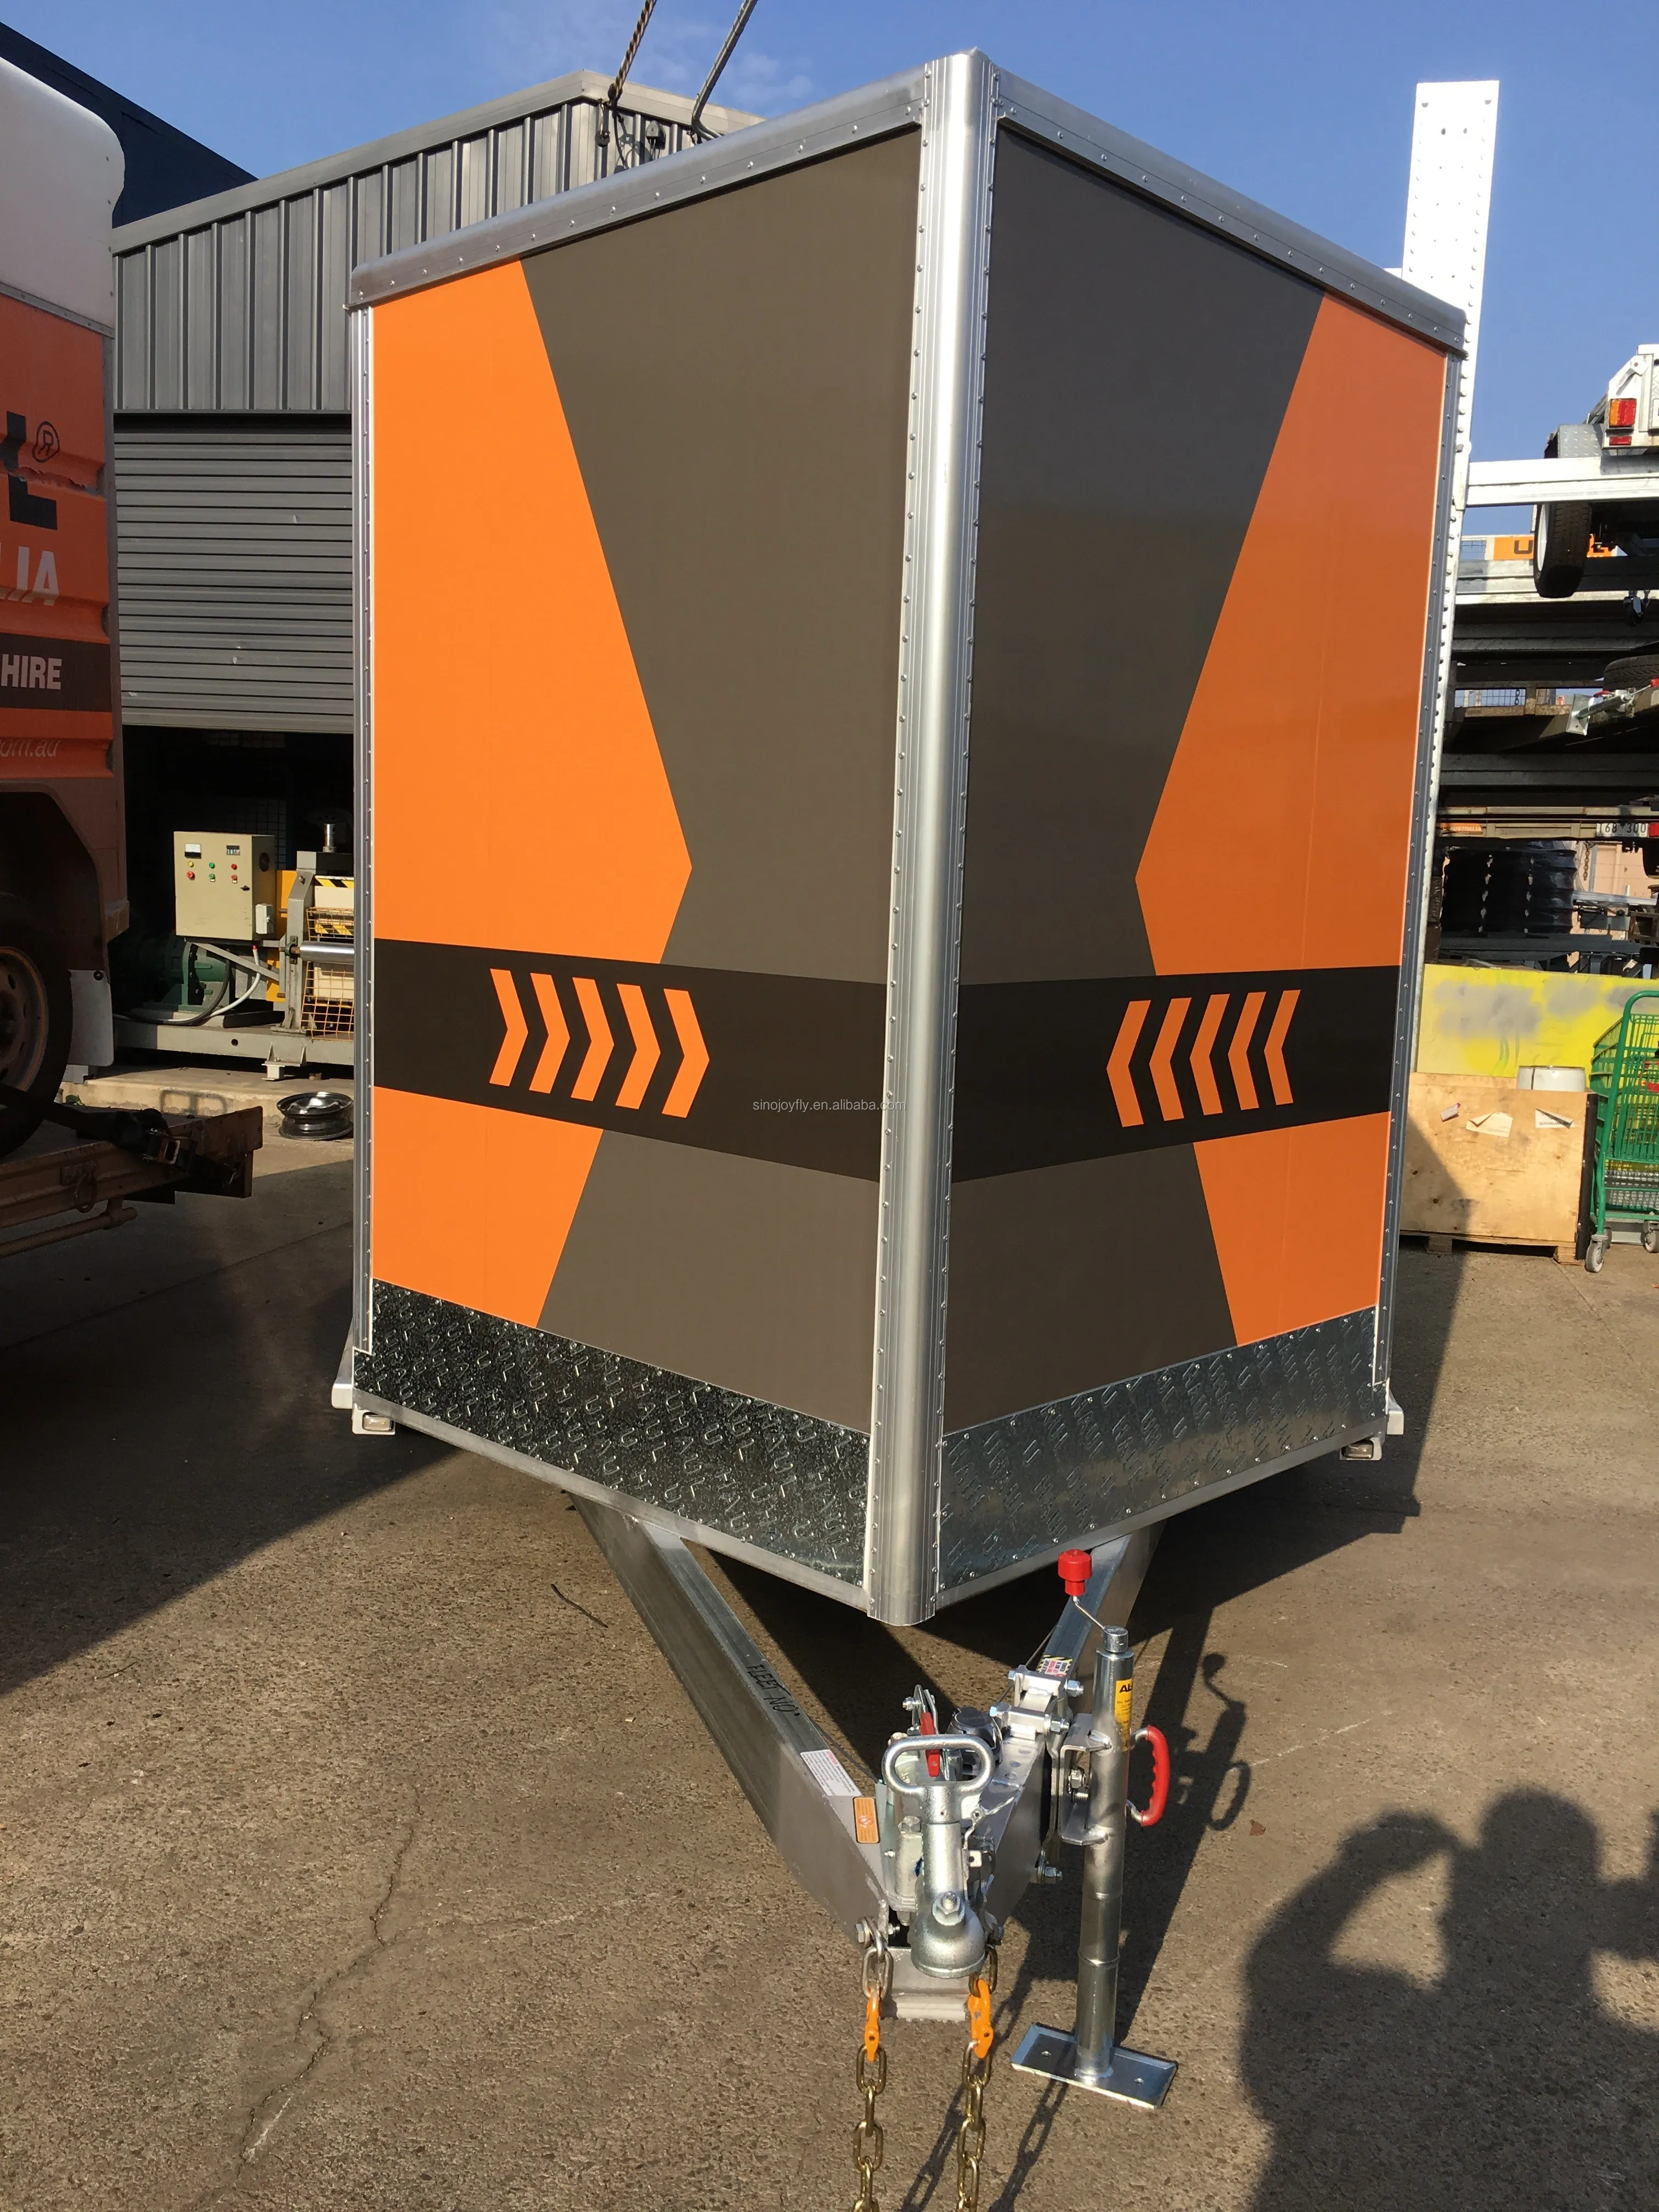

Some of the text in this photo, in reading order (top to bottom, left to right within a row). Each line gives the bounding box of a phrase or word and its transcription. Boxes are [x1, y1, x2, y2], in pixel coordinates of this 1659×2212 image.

[0, 542, 59, 606] IA
[1, 653, 63, 690] HIRE
[1626, 822, 1646, 833] 300
